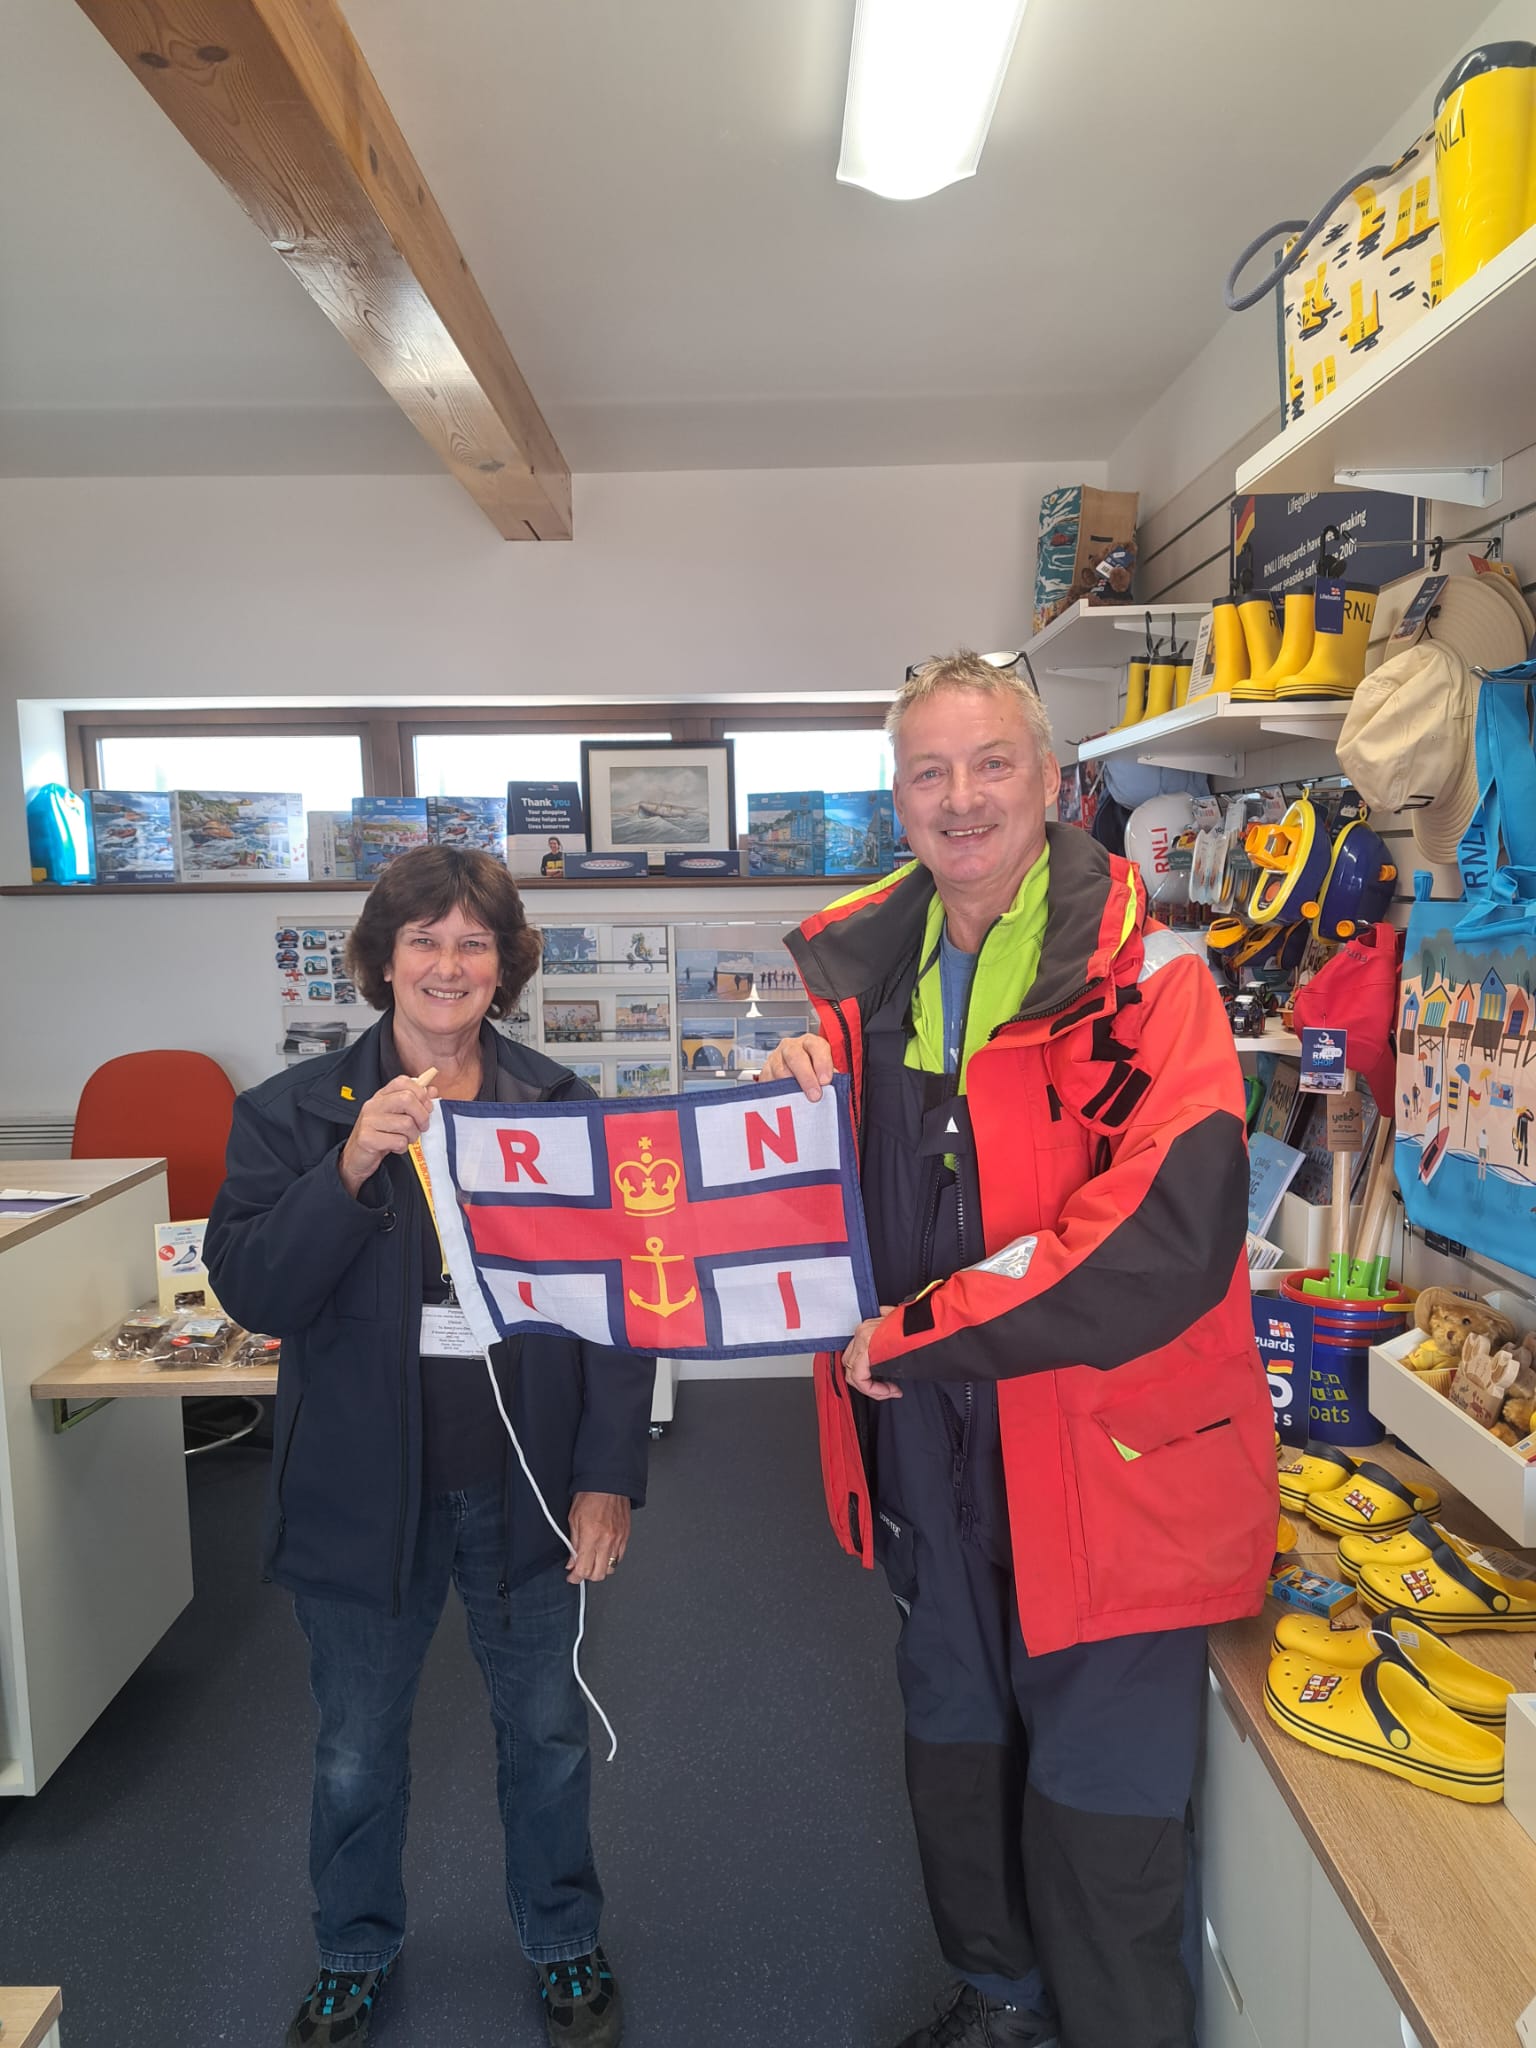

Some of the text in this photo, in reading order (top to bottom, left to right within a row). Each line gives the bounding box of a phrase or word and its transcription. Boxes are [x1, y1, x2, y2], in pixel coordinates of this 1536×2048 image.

[1339, 508, 1367, 535] making
[521, 797, 571, 808] Thank you
[1151, 827, 1170, 874] RNLI
[1460, 822, 1489, 889] RNLI
[1310, 1405, 1350, 1424] oats
